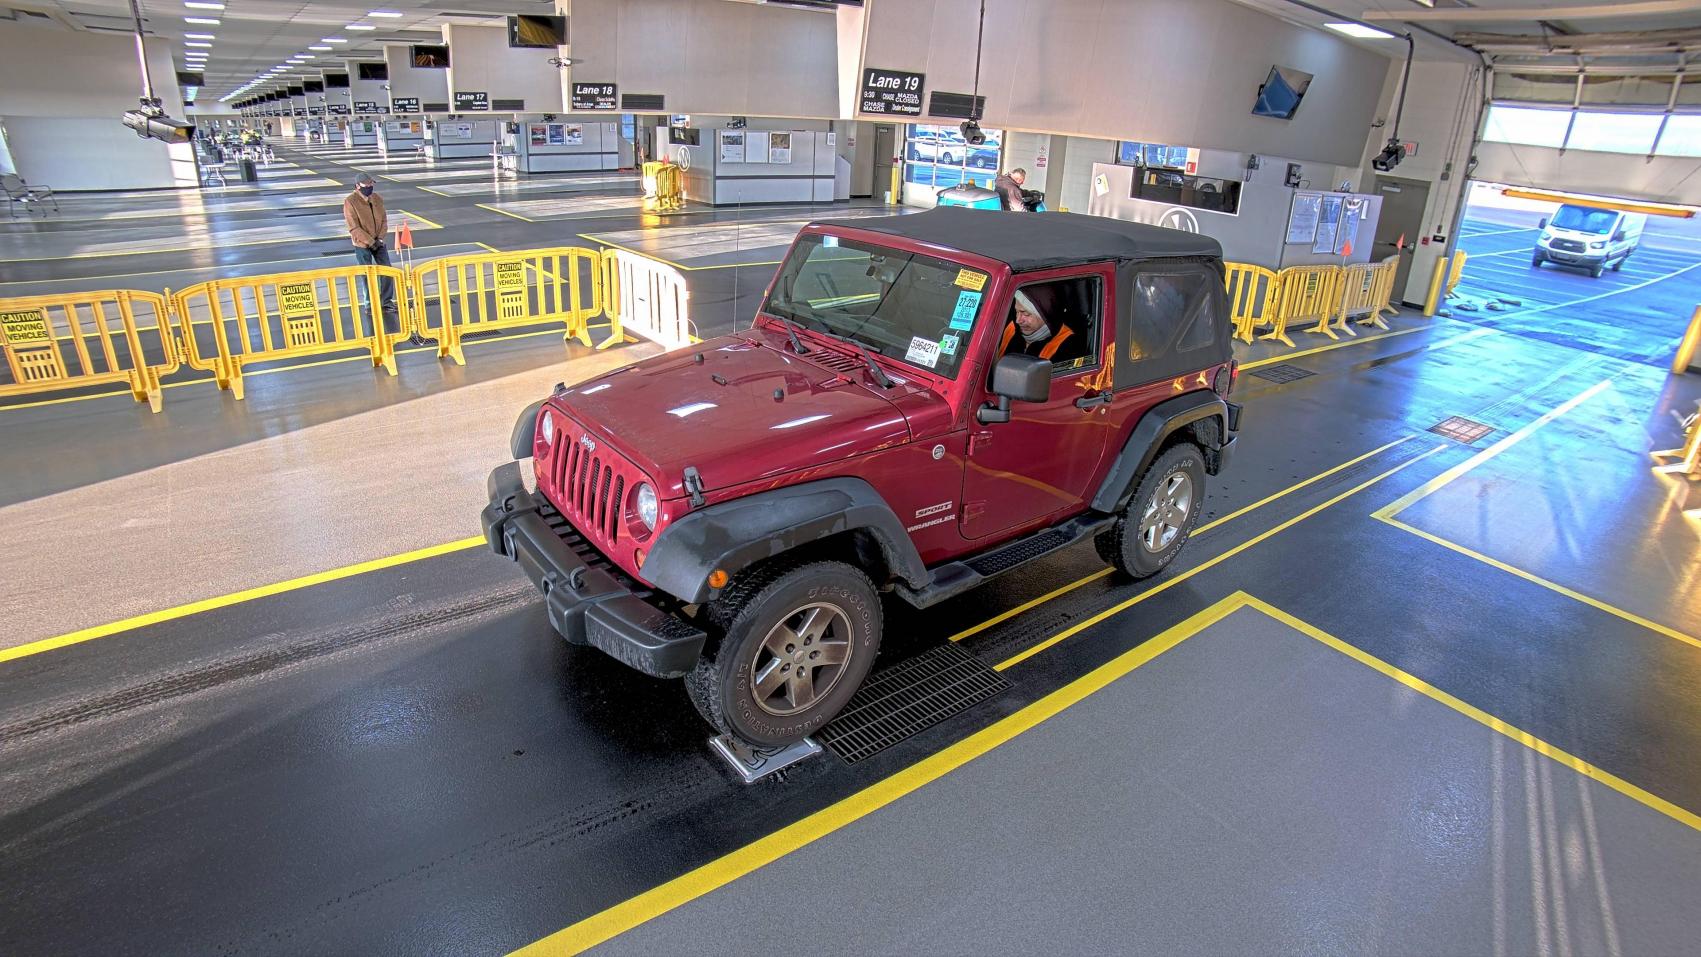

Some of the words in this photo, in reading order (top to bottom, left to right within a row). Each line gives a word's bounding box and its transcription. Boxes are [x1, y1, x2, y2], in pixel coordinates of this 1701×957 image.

[868, 72, 900, 88] Lane
[904, 77, 919, 91] 19
[576, 85, 600, 94] Lane
[602, 86, 613, 95] 18
[498, 263, 521, 272] CAUTION
[282, 285, 310, 294] CAUTION
[285, 302, 313, 310] VEHICLES
[1, 311, 42, 322] CAUTION
[7, 323, 43, 332] MOVING
[6, 331, 47, 340] VEHICLES
[911, 340, 938, 354] 5964211
[581, 433, 595, 452] Jeep
[917, 504, 949, 515] SPORT
[907, 514, 955, 532] WRANGLER
